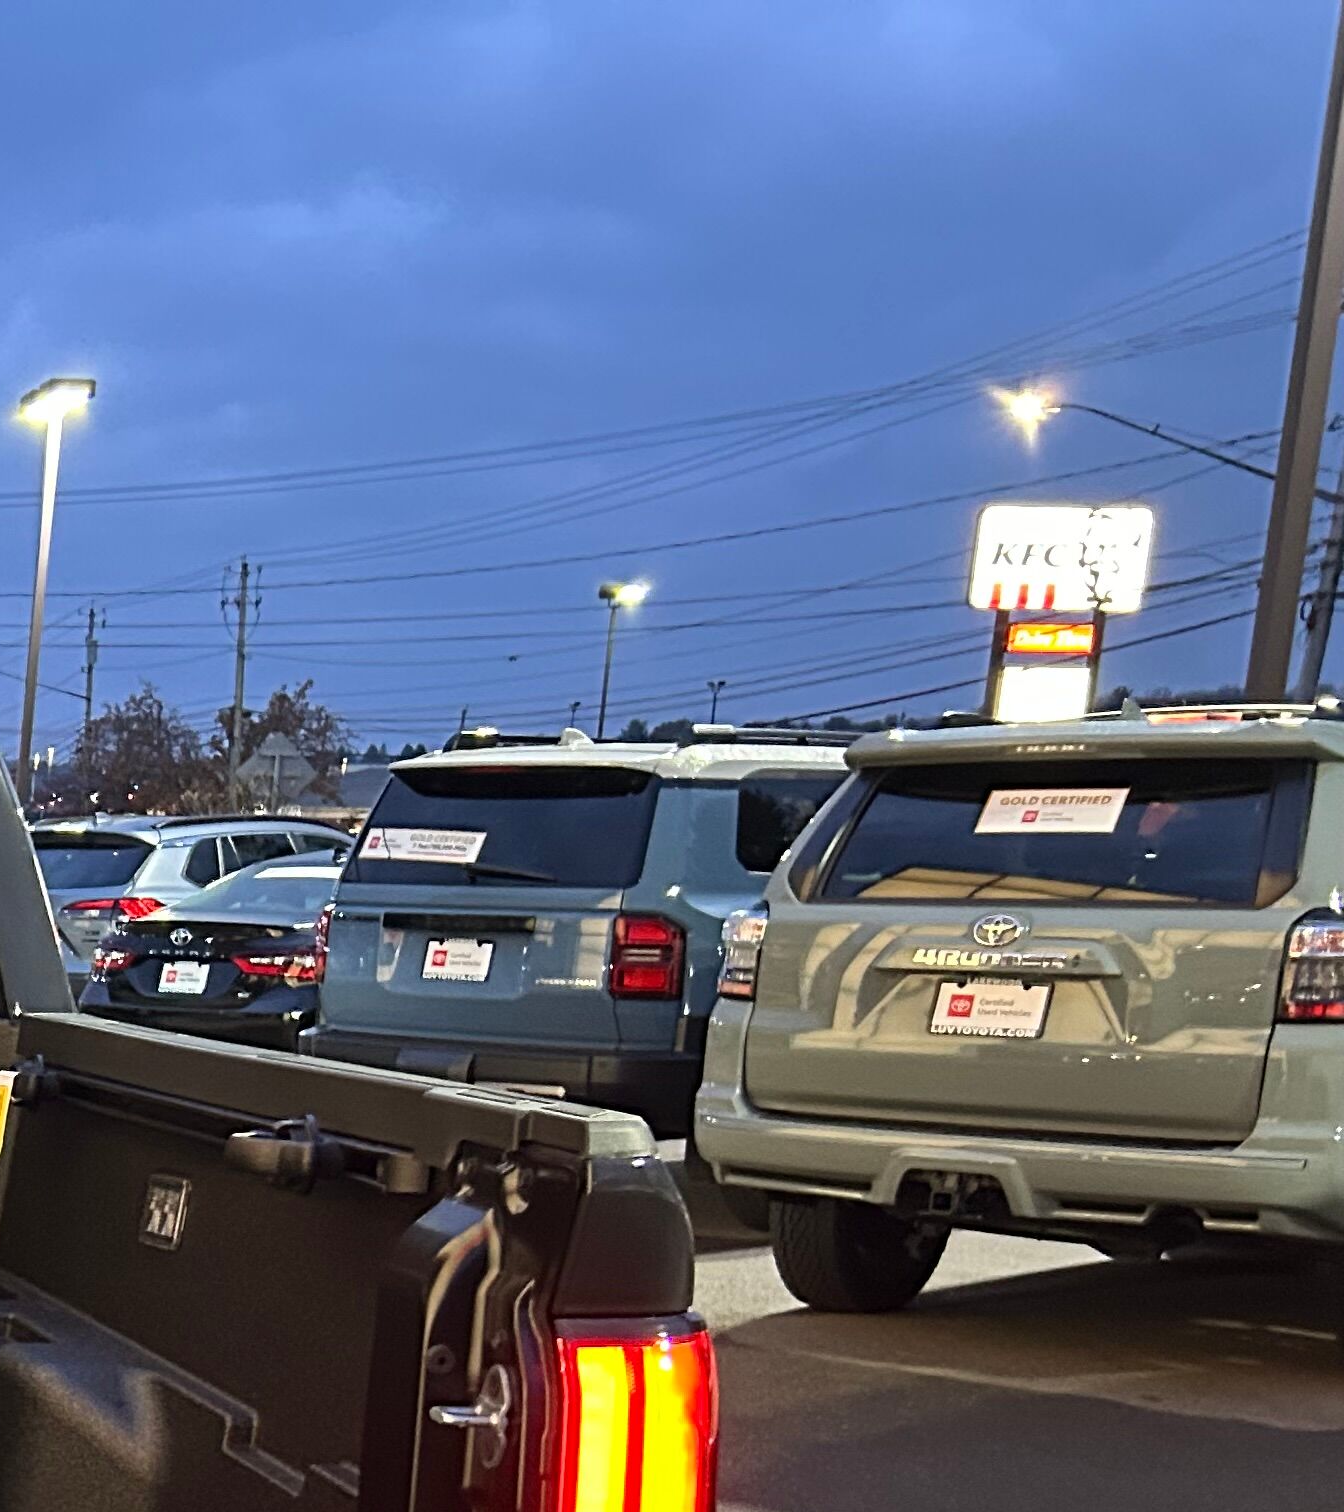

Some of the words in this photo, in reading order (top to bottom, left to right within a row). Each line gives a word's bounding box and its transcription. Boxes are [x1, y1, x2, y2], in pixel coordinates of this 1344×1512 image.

[992, 543, 1066, 567] KFC
[1000, 796, 1039, 806] GOLD
[1041, 795, 1112, 805] CERTIFIED
[979, 997, 1014, 1007] Certified
[977, 1008, 998, 1016] Used
[930, 1024, 1036, 1038] LUVTOYOTA.COM
